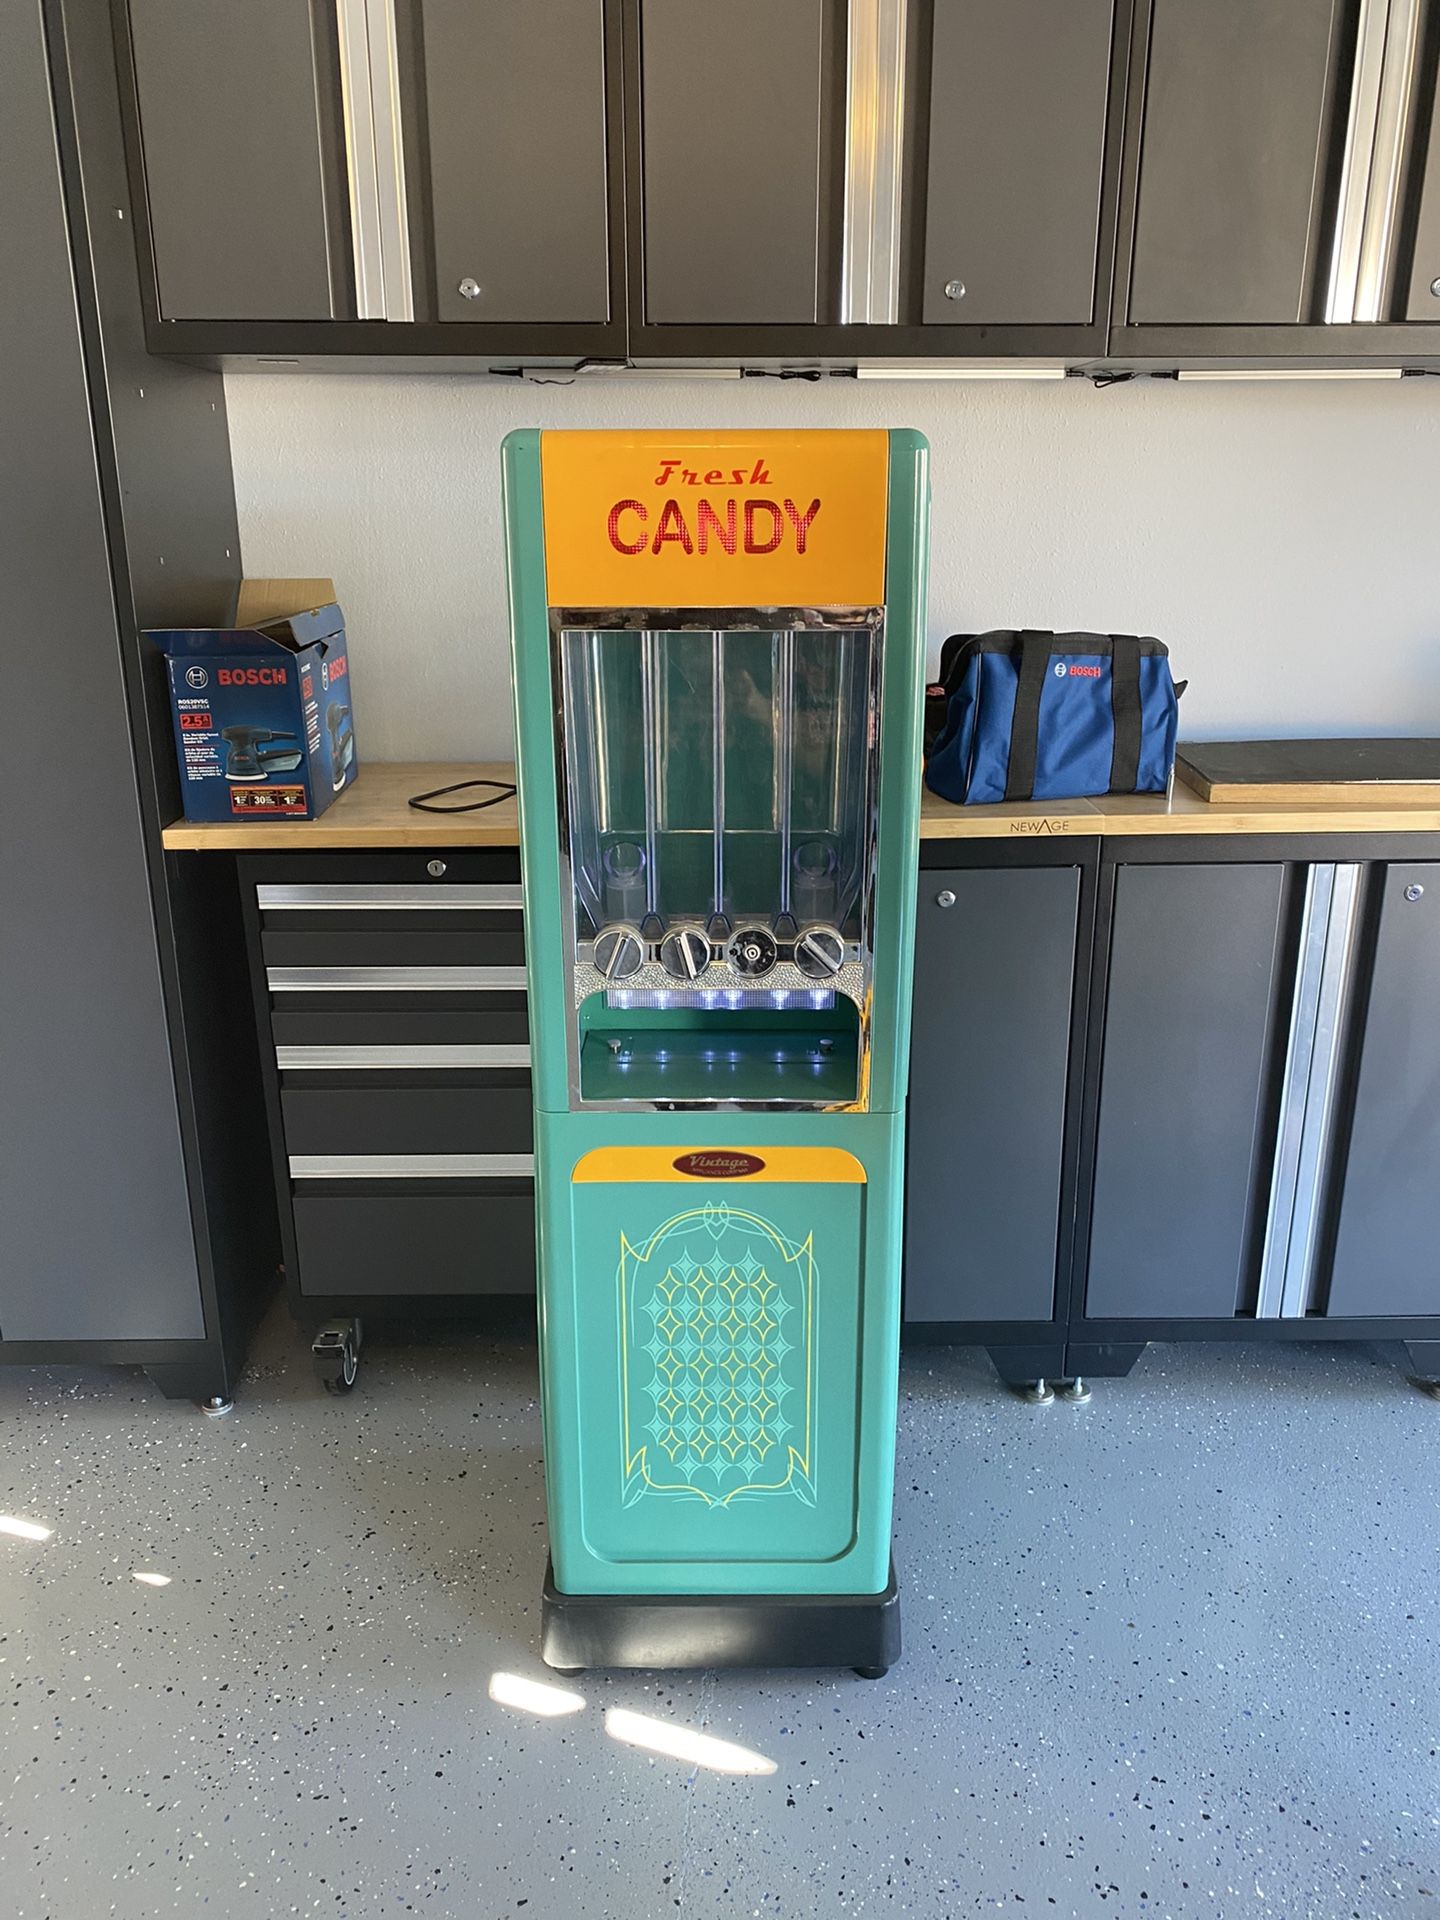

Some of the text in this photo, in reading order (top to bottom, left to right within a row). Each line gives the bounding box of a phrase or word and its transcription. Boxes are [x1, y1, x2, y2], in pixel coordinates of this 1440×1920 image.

[655, 459, 773, 485] Fresh
[607, 499, 821, 555] CANDY
[218, 668, 286, 685] BOSCH
[328, 656, 347, 682] BOSCH
[1070, 665, 1101, 677] BOSCH
[254, 796, 266, 804] 30
[1010, 820, 1069, 833] NEWAGE
[690, 1155, 750, 1169] Vintage
